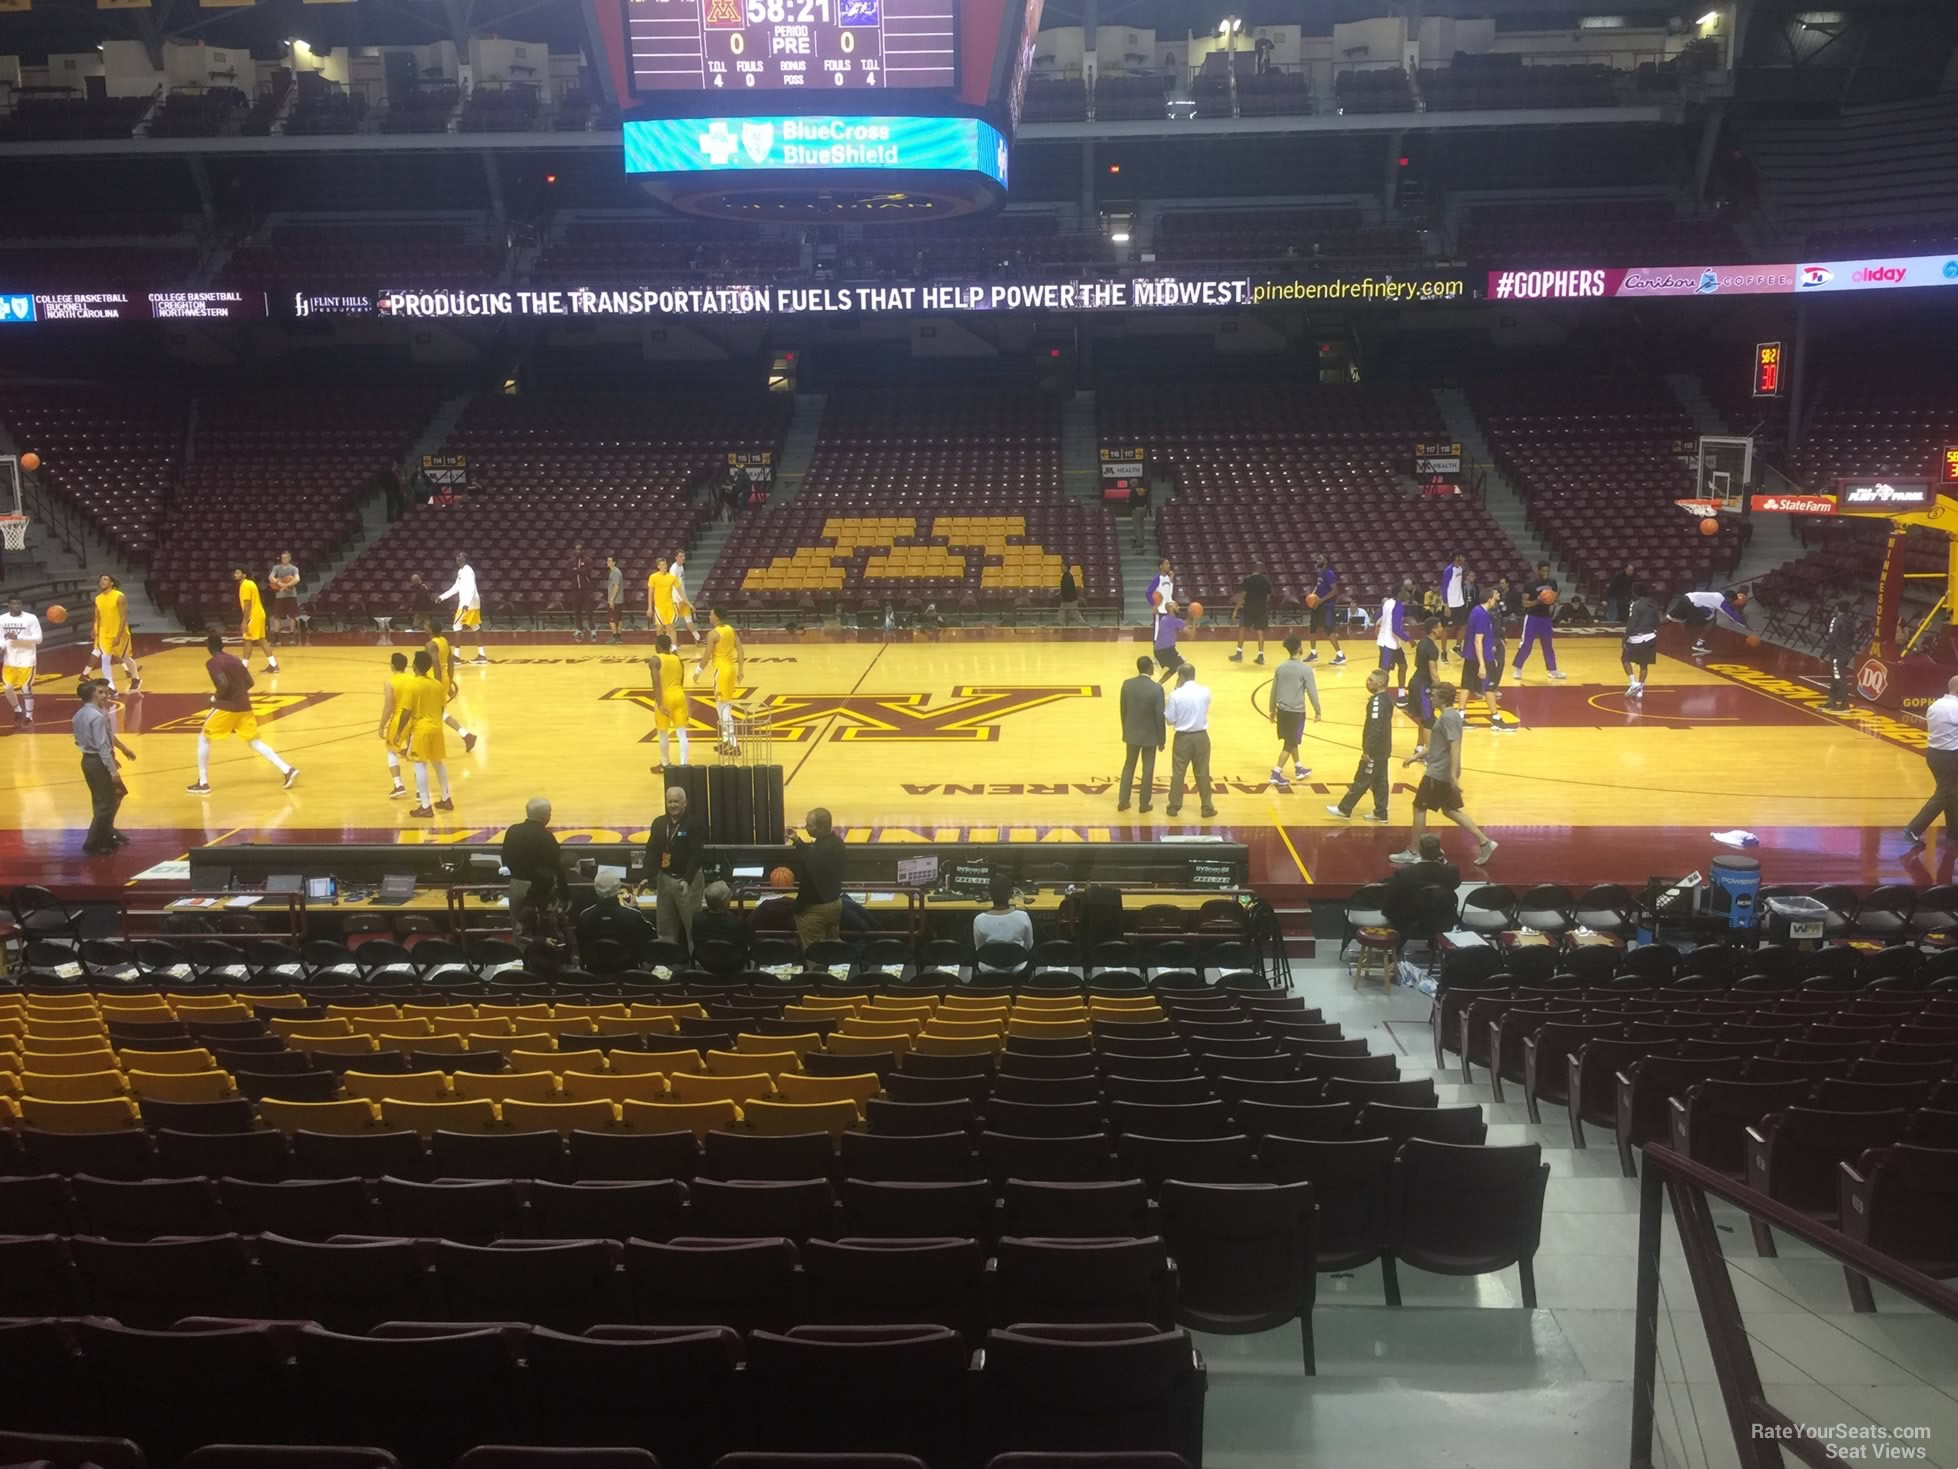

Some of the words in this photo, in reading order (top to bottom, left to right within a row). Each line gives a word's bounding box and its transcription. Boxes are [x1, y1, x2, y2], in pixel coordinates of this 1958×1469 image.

[748, 0, 829, 22] 58:21
[775, 26, 807, 37] PERIOD
[730, 33, 744, 54] 0
[772, 38, 810, 54] PRE
[841, 32, 854, 53] 0
[736, 61, 764, 72] FOULS
[780, 61, 806, 71] BONUS
[824, 60, 851, 71] FOULS
[713, 74, 723, 87] 4
[746, 74, 755, 87] 0
[783, 75, 804, 85] POSS
[834, 73, 843, 86] 0
[866, 72, 876, 85] 4
[783, 120, 890, 140] BlueCross
[783, 144, 898, 164] BlueShield
[1496, 270, 1605, 298] #GOPHERS
[1624, 275, 1695, 289] Caribou
[1722, 274, 1786, 287] COFFEE
[148, 293, 186, 301] COLLEGE
[188, 292, 242, 301] BASKETBALL
[1254, 278, 1463, 303] pinebendrefinery.com
[36, 295, 73, 303] COLLEGE
[75, 294, 128, 302] BASKETBALL
[314, 297, 339, 306] FLINT
[342, 297, 368, 306] HILLS
[390, 292, 512, 315] PRODUCING
[517, 292, 563, 313] THE
[567, 290, 770, 314] TRANSPORTATION
[778, 289, 852, 311] FUELS
[856, 288, 915, 310] THAT
[922, 286, 984, 308] HELP
[991, 284, 1075, 308] POWER
[1081, 284, 1126, 306] THE
[1134, 281, 1246, 305] MIDWEST
[159, 301, 206, 309] CREIGHTON
[47, 310, 76, 318] NORTH
[77, 309, 119, 318] CAROLINA
[159, 308, 229, 317] NORTHWESTERN
[1869, 538, 1896, 637] MINNESOTA
[1862, 668, 1883, 693] DQ
[900, 783, 1113, 796] ARENA
